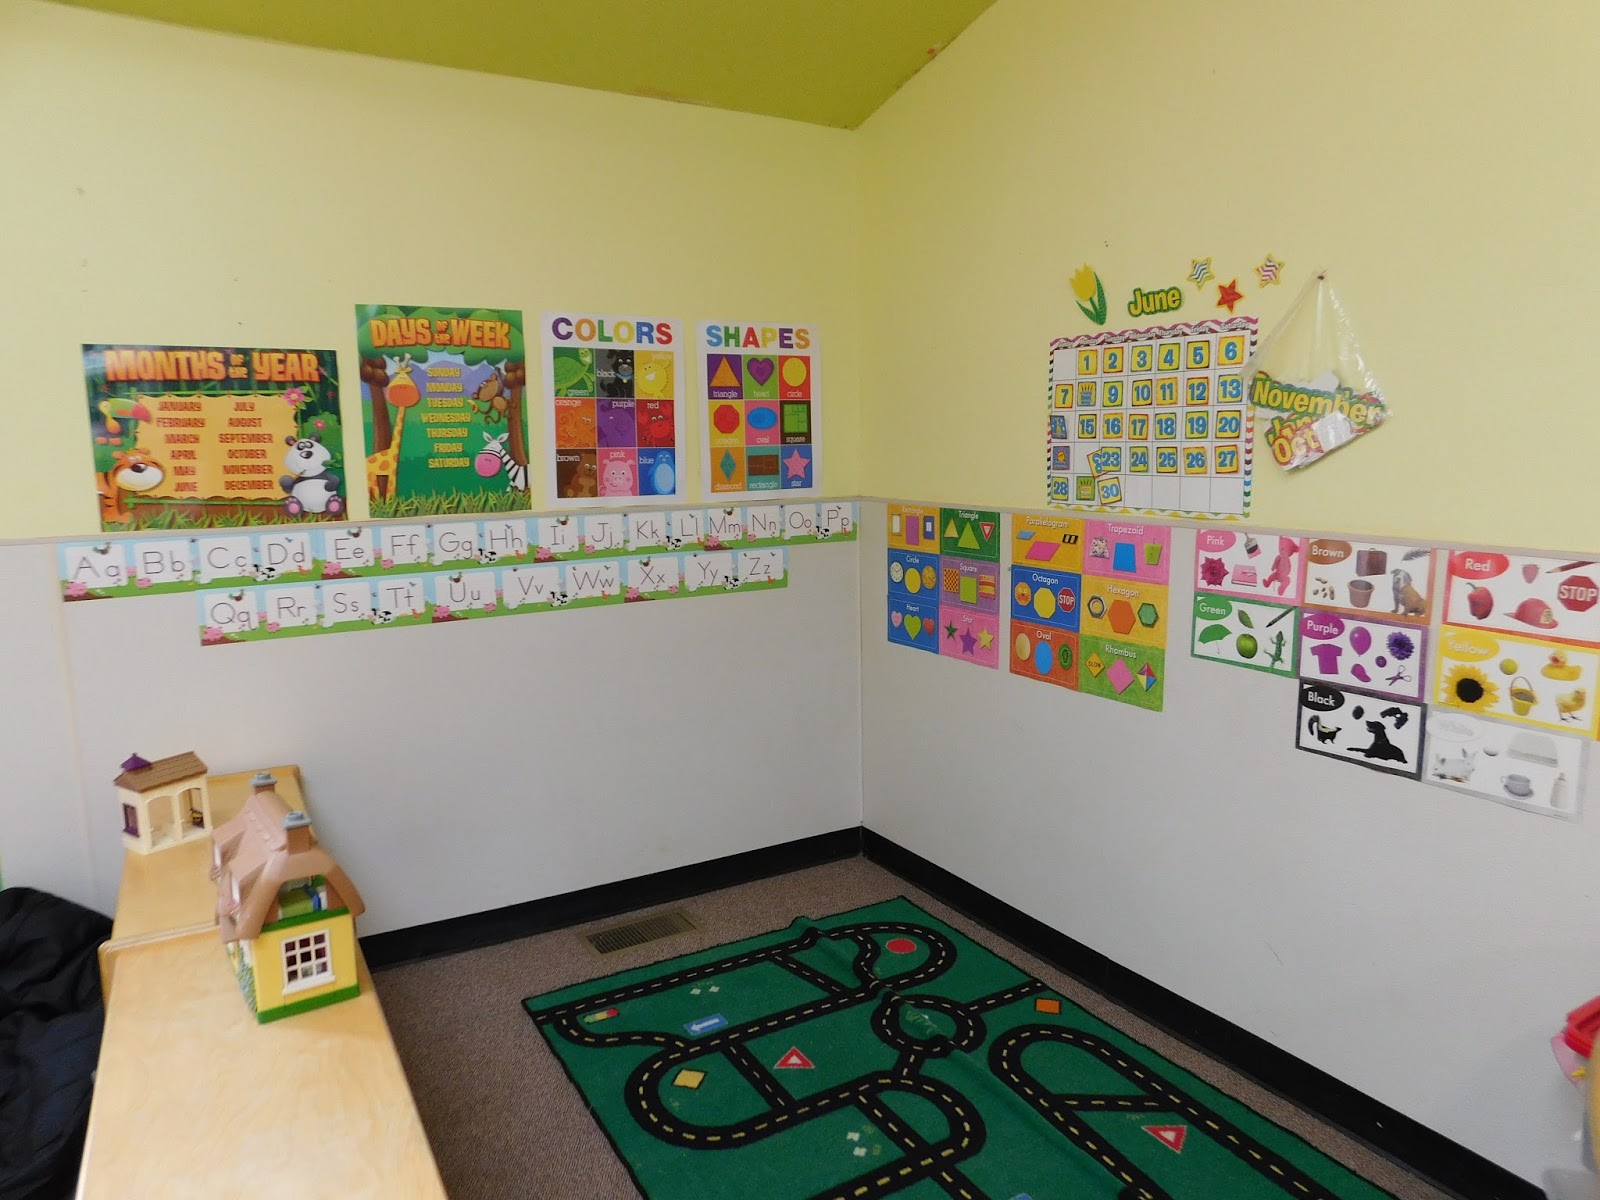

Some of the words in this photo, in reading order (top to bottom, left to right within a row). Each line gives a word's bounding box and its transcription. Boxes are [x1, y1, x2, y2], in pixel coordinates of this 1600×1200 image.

[1128, 287, 1181, 317] June
[370, 317, 432, 348] DAYS
[449, 317, 511, 350] WEEK
[552, 317, 674, 345] COLORS
[706, 325, 811, 349] SHAPES
[1083, 355, 1090, 371] 1
[1108, 352, 1118, 369] 2
[1136, 350, 1147, 368] 3
[1163, 348, 1174, 366] 4
[1193, 346, 1204, 364] 5
[1225, 341, 1237, 361] 6
[105, 350, 226, 381] MONTHS
[251, 352, 322, 383] YEAR
[427, 367, 461, 377] SUNDAY
[596, 369, 616, 378] black
[426, 382, 463, 393] MONDAY
[1061, 388, 1069, 405] 7
[1107, 385, 1118, 403] 9
[1134, 384, 1150, 401] 10
[1160, 383, 1174, 400] 11
[1188, 381, 1206, 400] 12
[1220, 379, 1241, 399] 13
[713, 390, 738, 399] triangle
[233, 402, 255, 411] JULY
[427, 397, 465, 408] TUESDAY
[612, 400, 635, 409] purple
[647, 401, 660, 410] red
[1253, 380, 1382, 424] November
[421, 412, 472, 423] WEDNESDAY
[1080, 418, 1094, 434] 15
[1105, 417, 1121, 434] 16
[1131, 418, 1145, 435] 17
[1157, 417, 1174, 436] 18
[1188, 416, 1207, 434] 19
[1218, 416, 1239, 433] 20
[427, 427, 469, 438] THURSDAY
[218, 433, 274, 444] SEPTEMBER
[434, 442, 463, 453] FRIDAY
[556, 454, 581, 462] brown
[610, 449, 626, 459] pink
[1101, 452, 1120, 468] 23
[1131, 451, 1148, 467] 24
[1158, 451, 1176, 467] 25
[1186, 452, 1205, 468] 26
[1217, 450, 1236, 467] 27
[428, 457, 470, 468] SATURDAY
[638, 456, 654, 465] blue
[223, 465, 274, 475] NOVEMBER
[224, 480, 274, 491] DECEMBER
[749, 481, 778, 490] rectangle
[791, 480, 802, 488] star
[1053, 482, 1068, 496] 28
[1101, 484, 1119, 499] 30
[958, 510, 979, 520] Triangle
[1026, 516, 1069, 529] Parallelogram
[1108, 523, 1144, 536] Trapezoid
[1206, 535, 1225, 546] Pink
[1311, 545, 1344, 558] Brown
[906, 554, 919, 564] Circle
[960, 563, 978, 573] Square
[1465, 558, 1491, 572] Red
[1032, 572, 1059, 585] Octagon
[1107, 584, 1140, 598] Hexagon
[1560, 586, 1597, 602] STOP
[1059, 595, 1075, 606] STOP
[906, 602, 919, 612] Heart
[1199, 602, 1226, 615] Green
[963, 614, 974, 624] Star
[1306, 620, 1339, 635] Purple
[1036, 630, 1052, 641] Oval
[1105, 643, 1137, 659] Rhombus
[1307, 691, 1336, 707] Black
